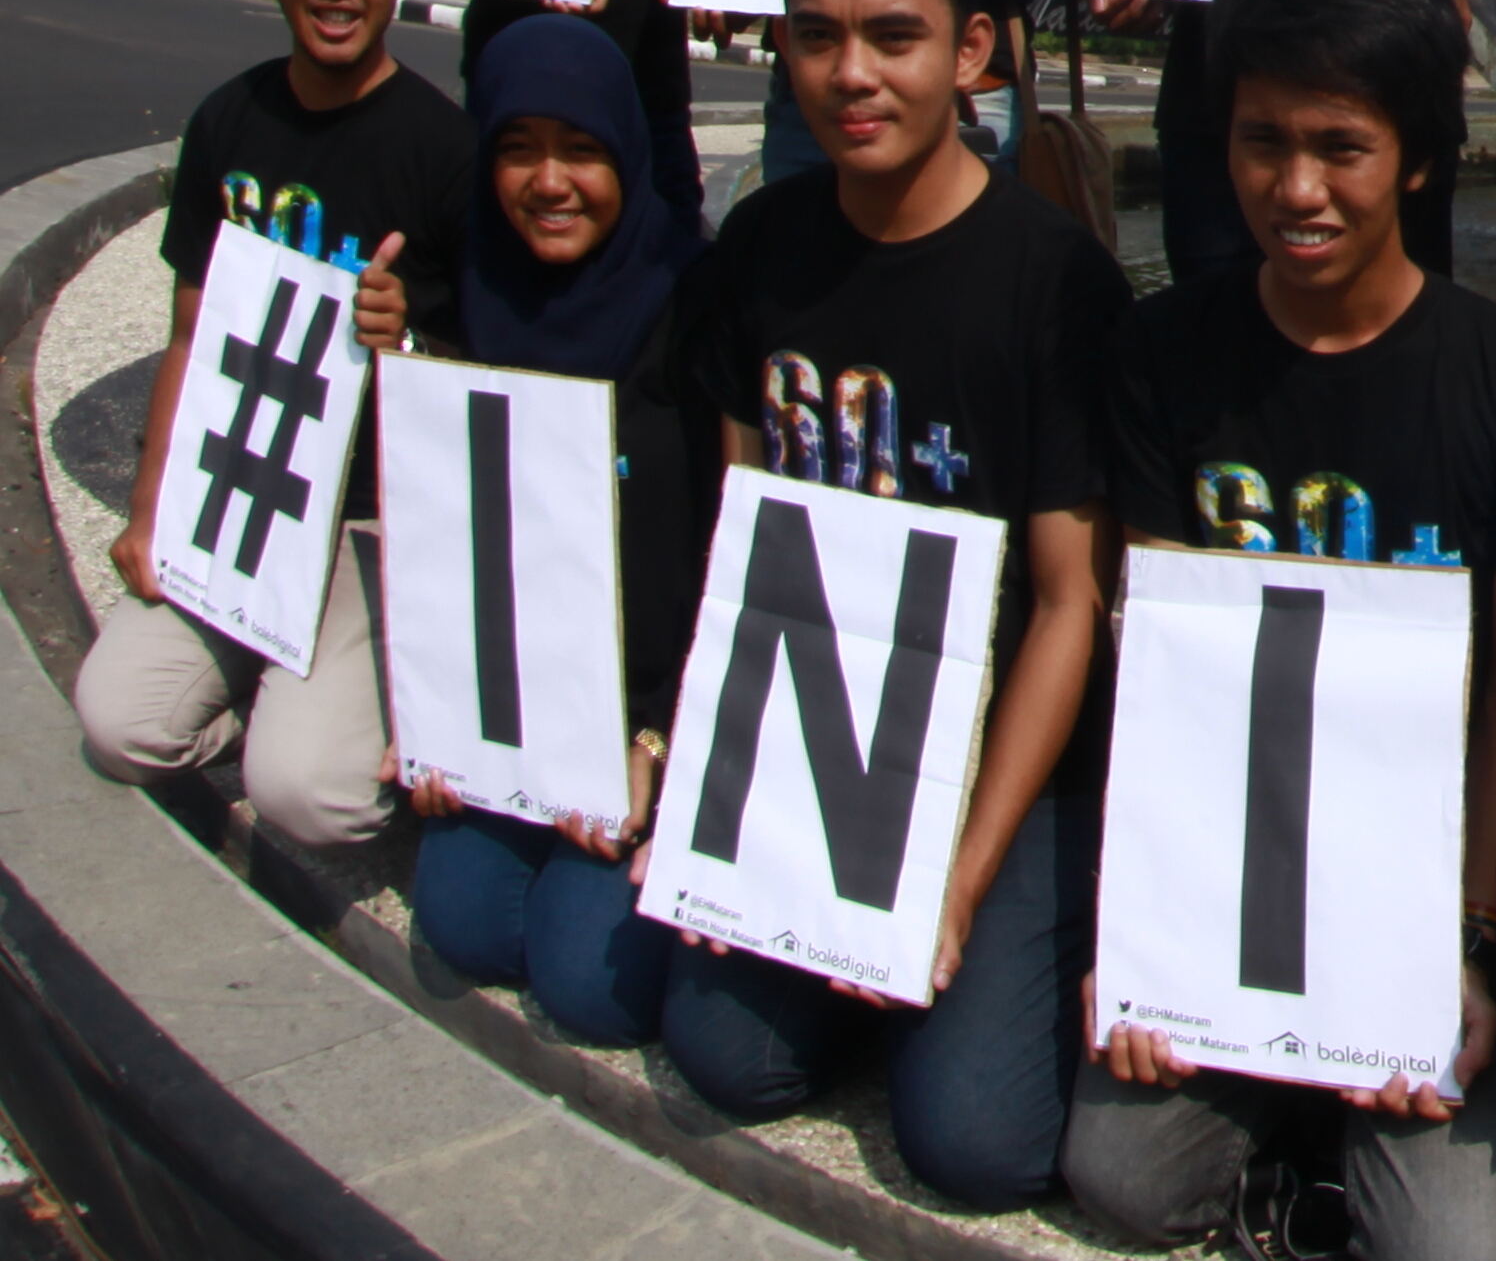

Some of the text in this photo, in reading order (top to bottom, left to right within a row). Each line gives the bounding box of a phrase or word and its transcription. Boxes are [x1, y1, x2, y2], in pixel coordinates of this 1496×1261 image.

[192, 277, 339, 579] #
[468, 390, 523, 748] I
[691, 496, 957, 912] N
[1239, 585, 1324, 996] I
[687, 912, 708, 929] Earth
[709, 920, 729, 936] Hour
[807, 942, 890, 983] balèdigital
[1136, 1004, 1212, 1028] @EHMataram
[1168, 1030, 1249, 1055] Hour Mataram
[1317, 1042, 1436, 1074] balèdigital
